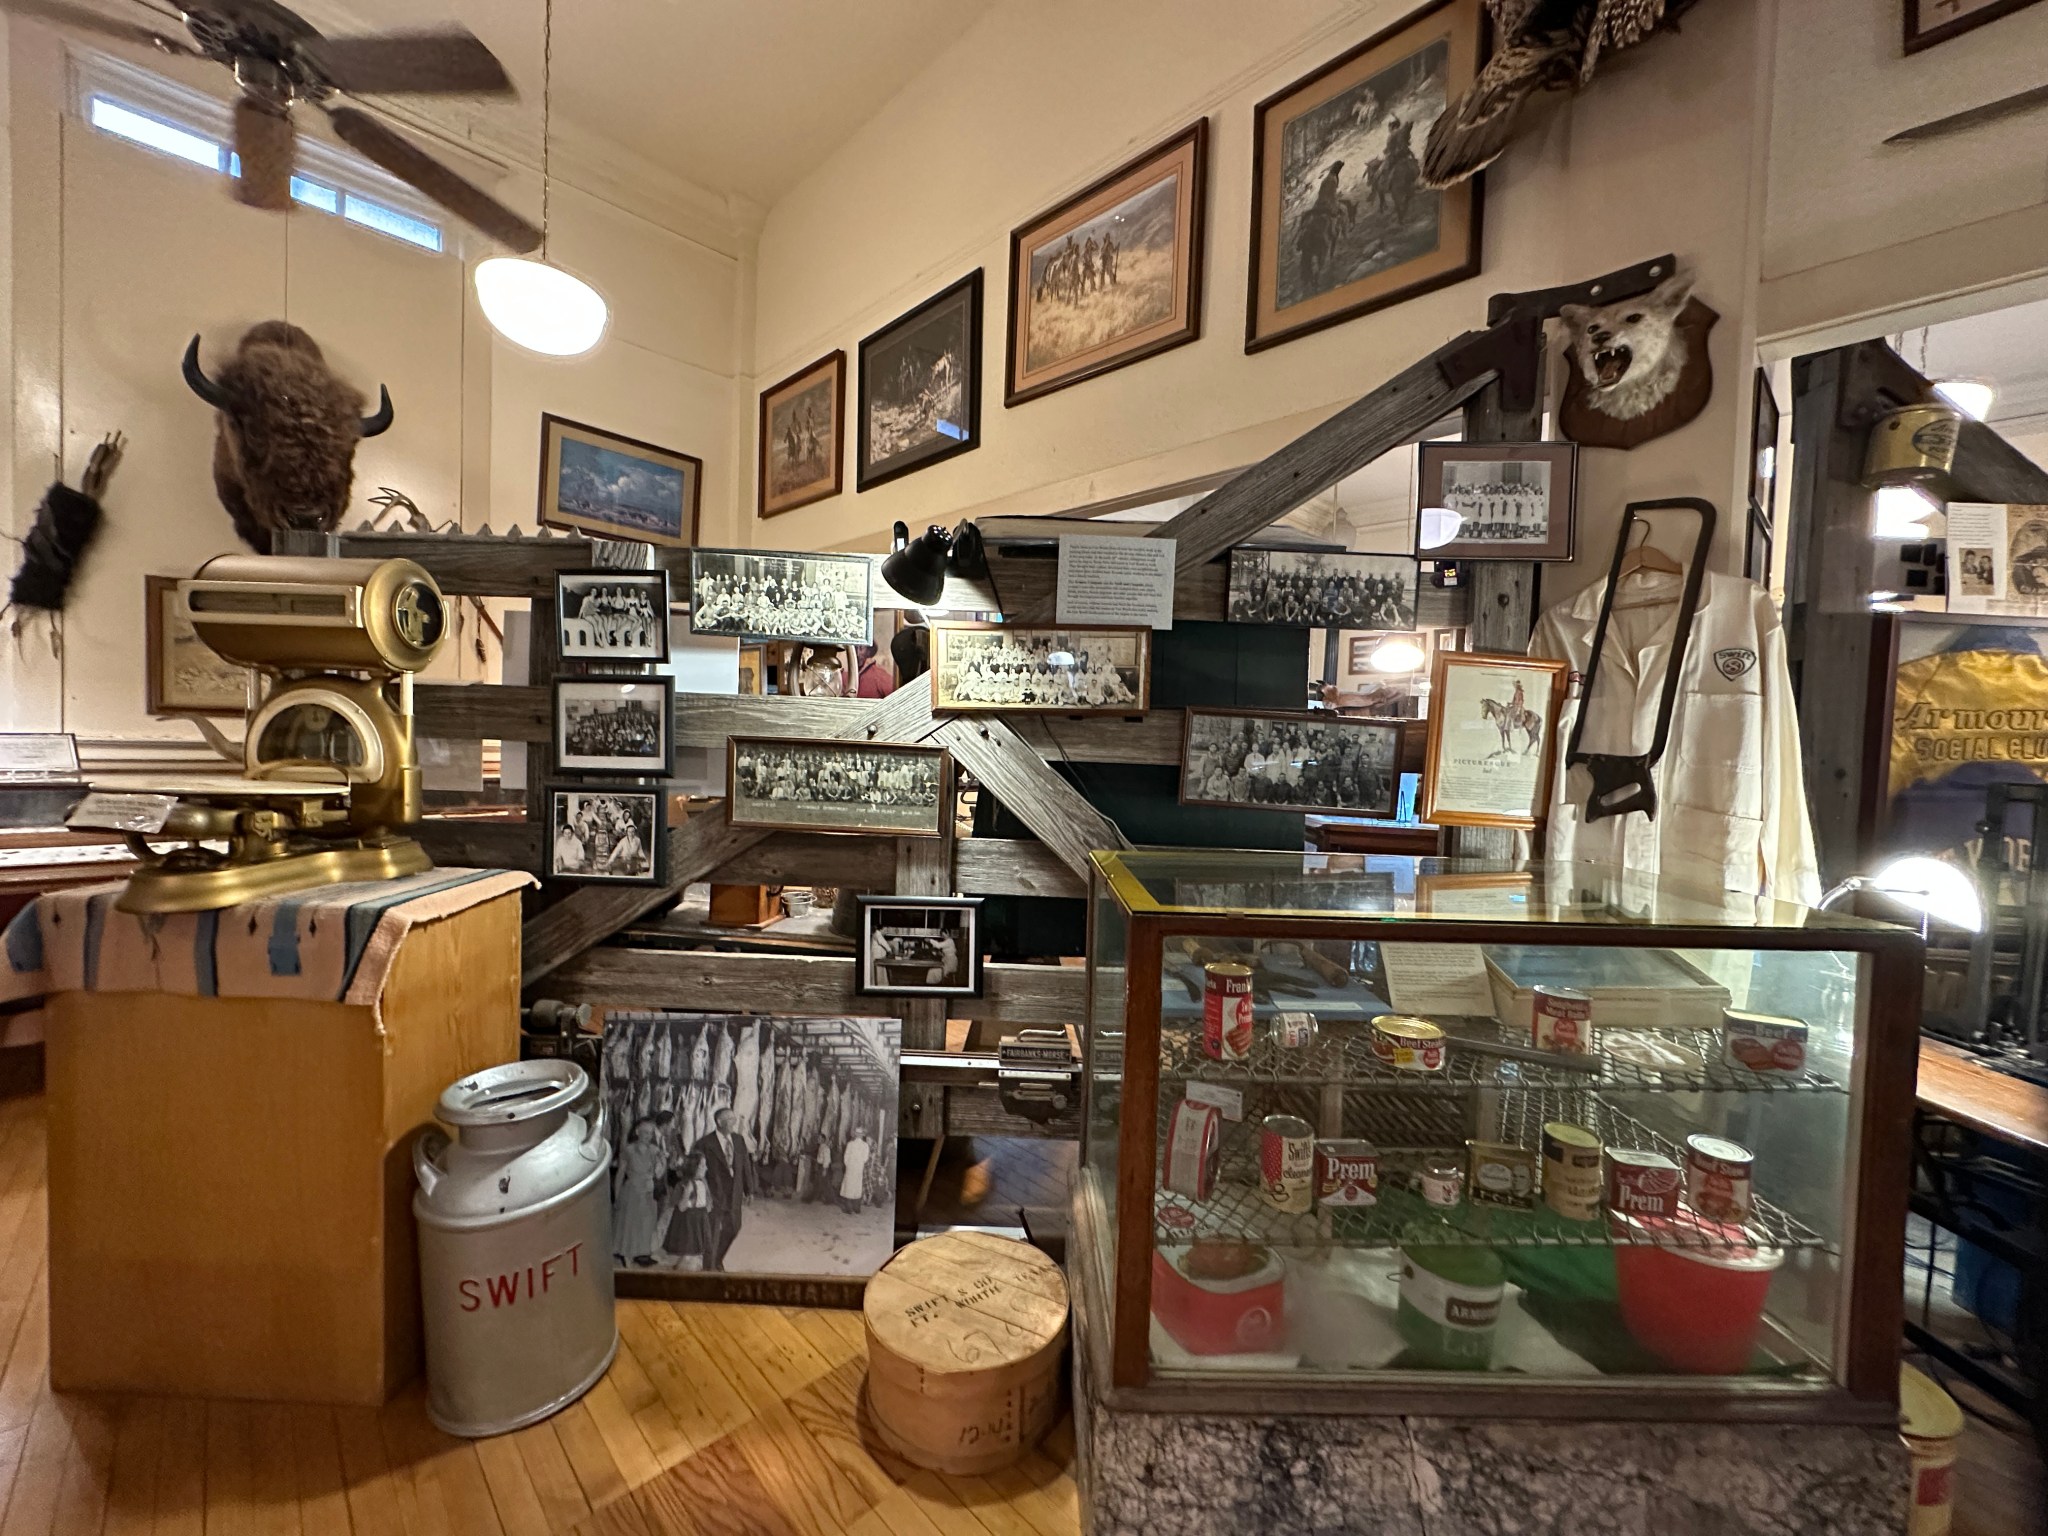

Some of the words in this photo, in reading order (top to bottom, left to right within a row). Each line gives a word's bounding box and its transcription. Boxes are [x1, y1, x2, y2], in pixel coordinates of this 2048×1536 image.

[1718, 651, 1752, 660] Swift
[1915, 737, 2001, 761] SOCIAL
[1006, 1048, 1066, 1061] FAIRBANKS-MORSE
[1327, 1157, 1375, 1180] Prem
[1618, 1184, 1664, 1213] Prem
[459, 1242, 583, 1313] SWIFT
[904, 1294, 950, 1318] SWIFT
